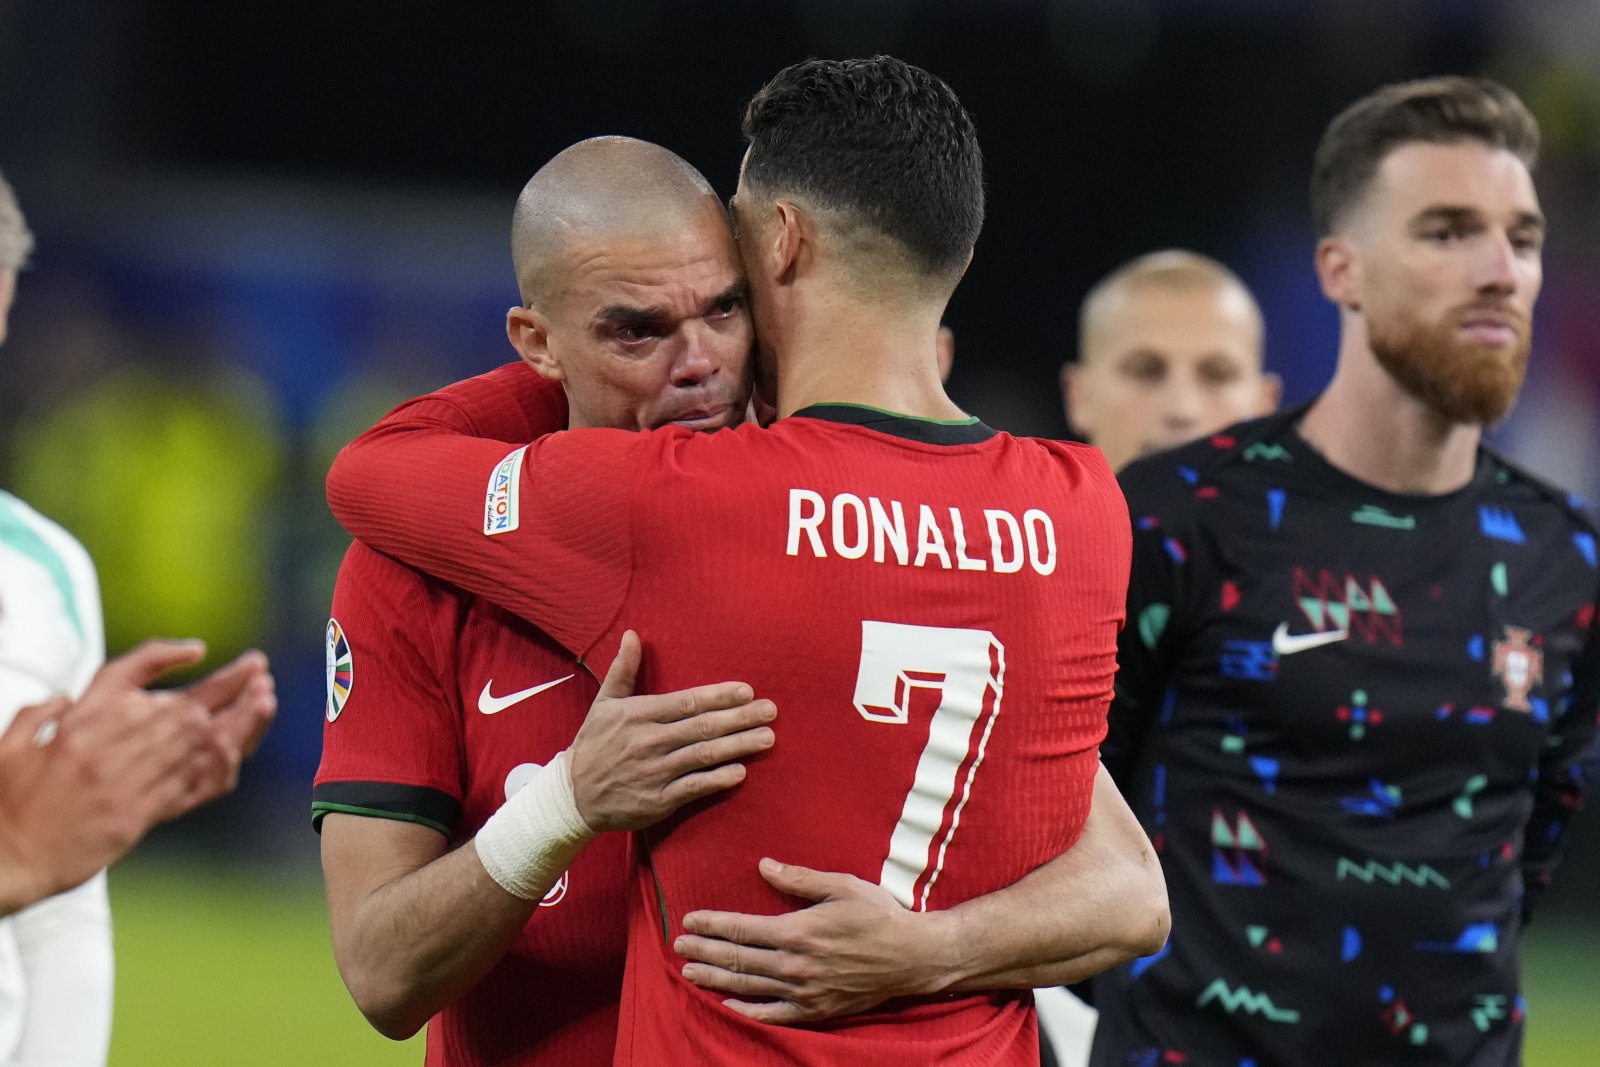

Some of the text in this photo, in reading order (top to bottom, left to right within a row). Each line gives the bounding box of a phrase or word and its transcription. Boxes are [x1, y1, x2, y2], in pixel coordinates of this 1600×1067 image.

[487, 493, 495, 503] for
[786, 488, 1057, 576] RONALDO
[852, 620, 1005, 913] 7
